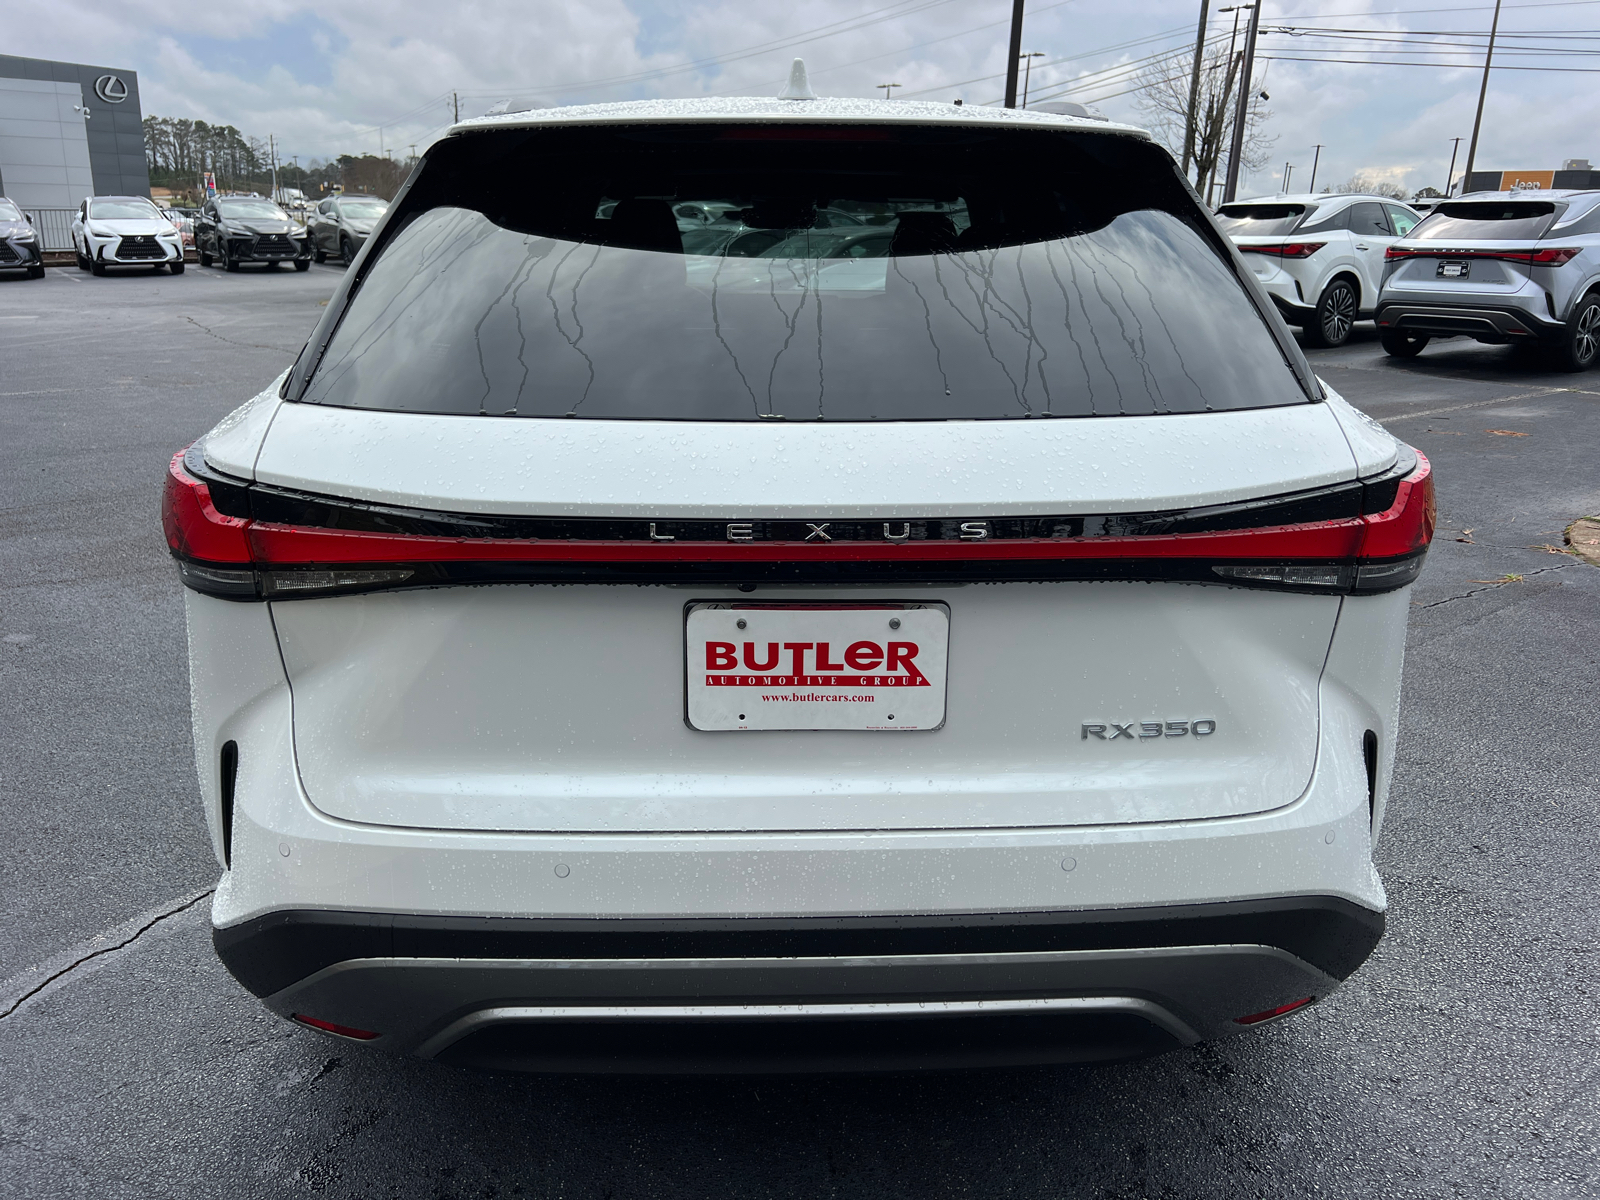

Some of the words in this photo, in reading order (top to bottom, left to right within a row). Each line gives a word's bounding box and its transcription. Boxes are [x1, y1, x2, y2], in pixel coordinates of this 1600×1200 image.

[1510, 178, 1541, 190] Jeep
[649, 522, 989, 541] LEXUS
[706, 676, 838, 686] AUTOMOTIVE
[859, 676, 924, 686] GROUP
[761, 692, 876, 703] www.butlercars.com
[1081, 718, 1216, 741] RX350
